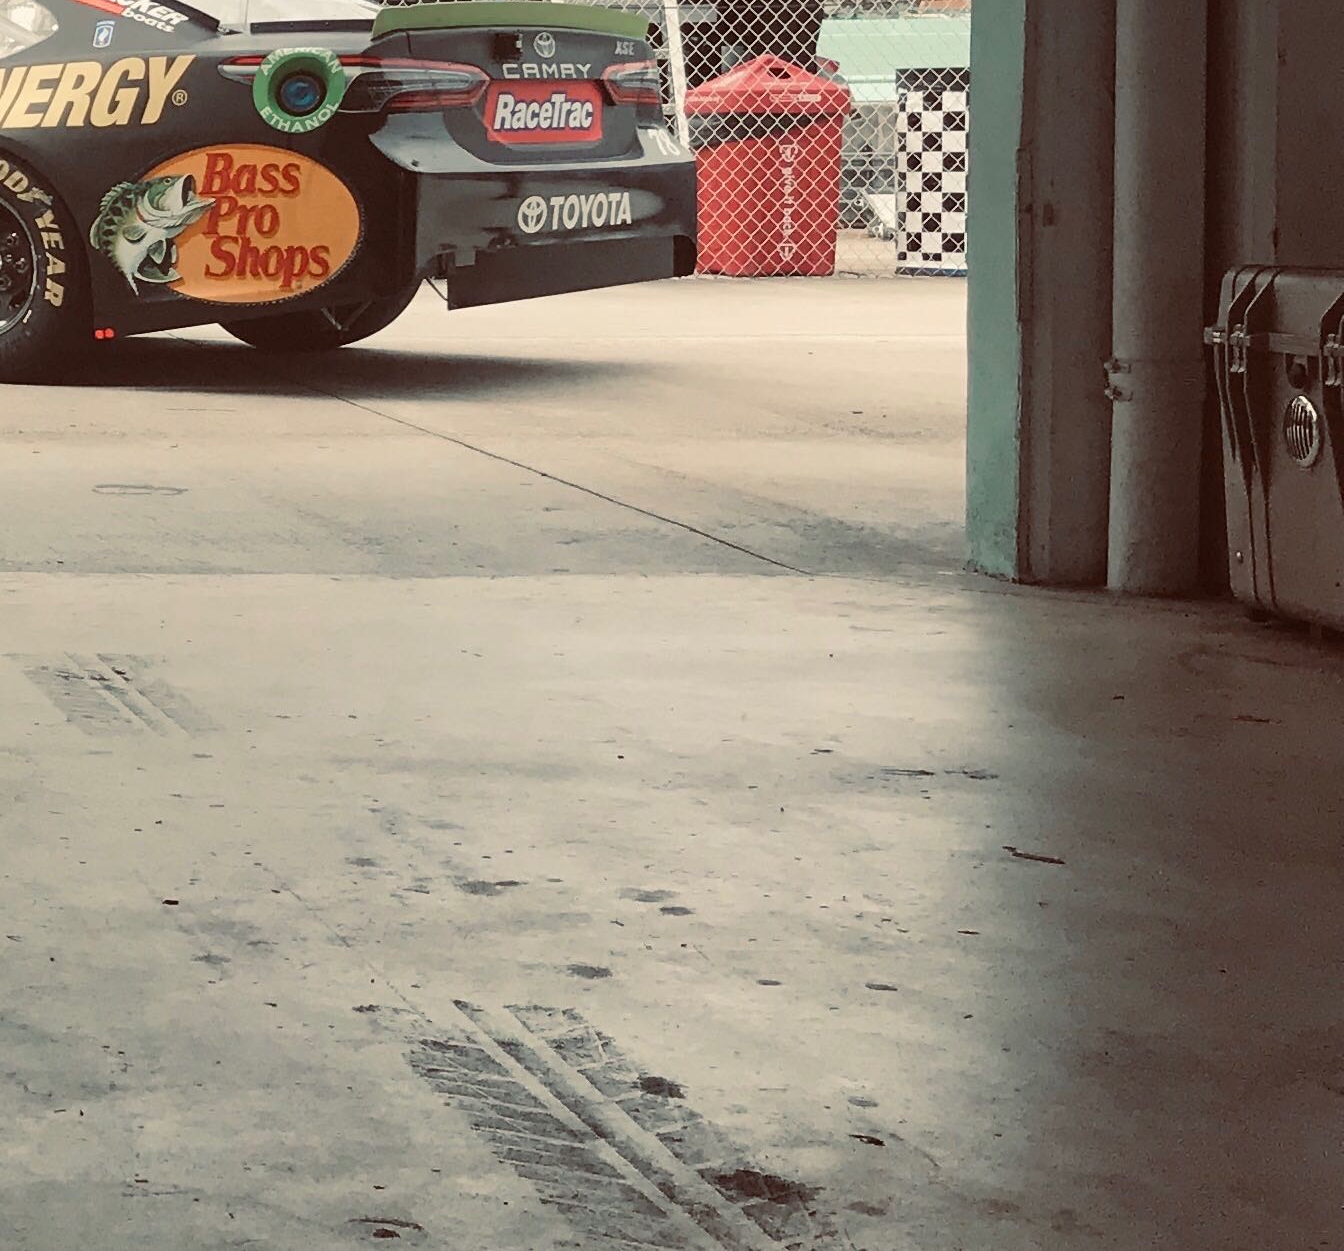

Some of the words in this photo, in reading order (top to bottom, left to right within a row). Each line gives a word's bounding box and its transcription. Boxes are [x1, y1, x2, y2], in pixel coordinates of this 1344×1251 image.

[121, 7, 175, 33] boats
[260, 47, 342, 76] AMERICAN
[614, 40, 636, 56] XSE
[259, 100, 339, 134] ETHANOL
[493, 93, 594, 131] RaceTrac
[646, 128, 682, 157] 78
[198, 152, 302, 197] Bass
[202, 195, 281, 237] Pro
[550, 191, 633, 230] TOYOTA
[204, 235, 331, 291] Shops
